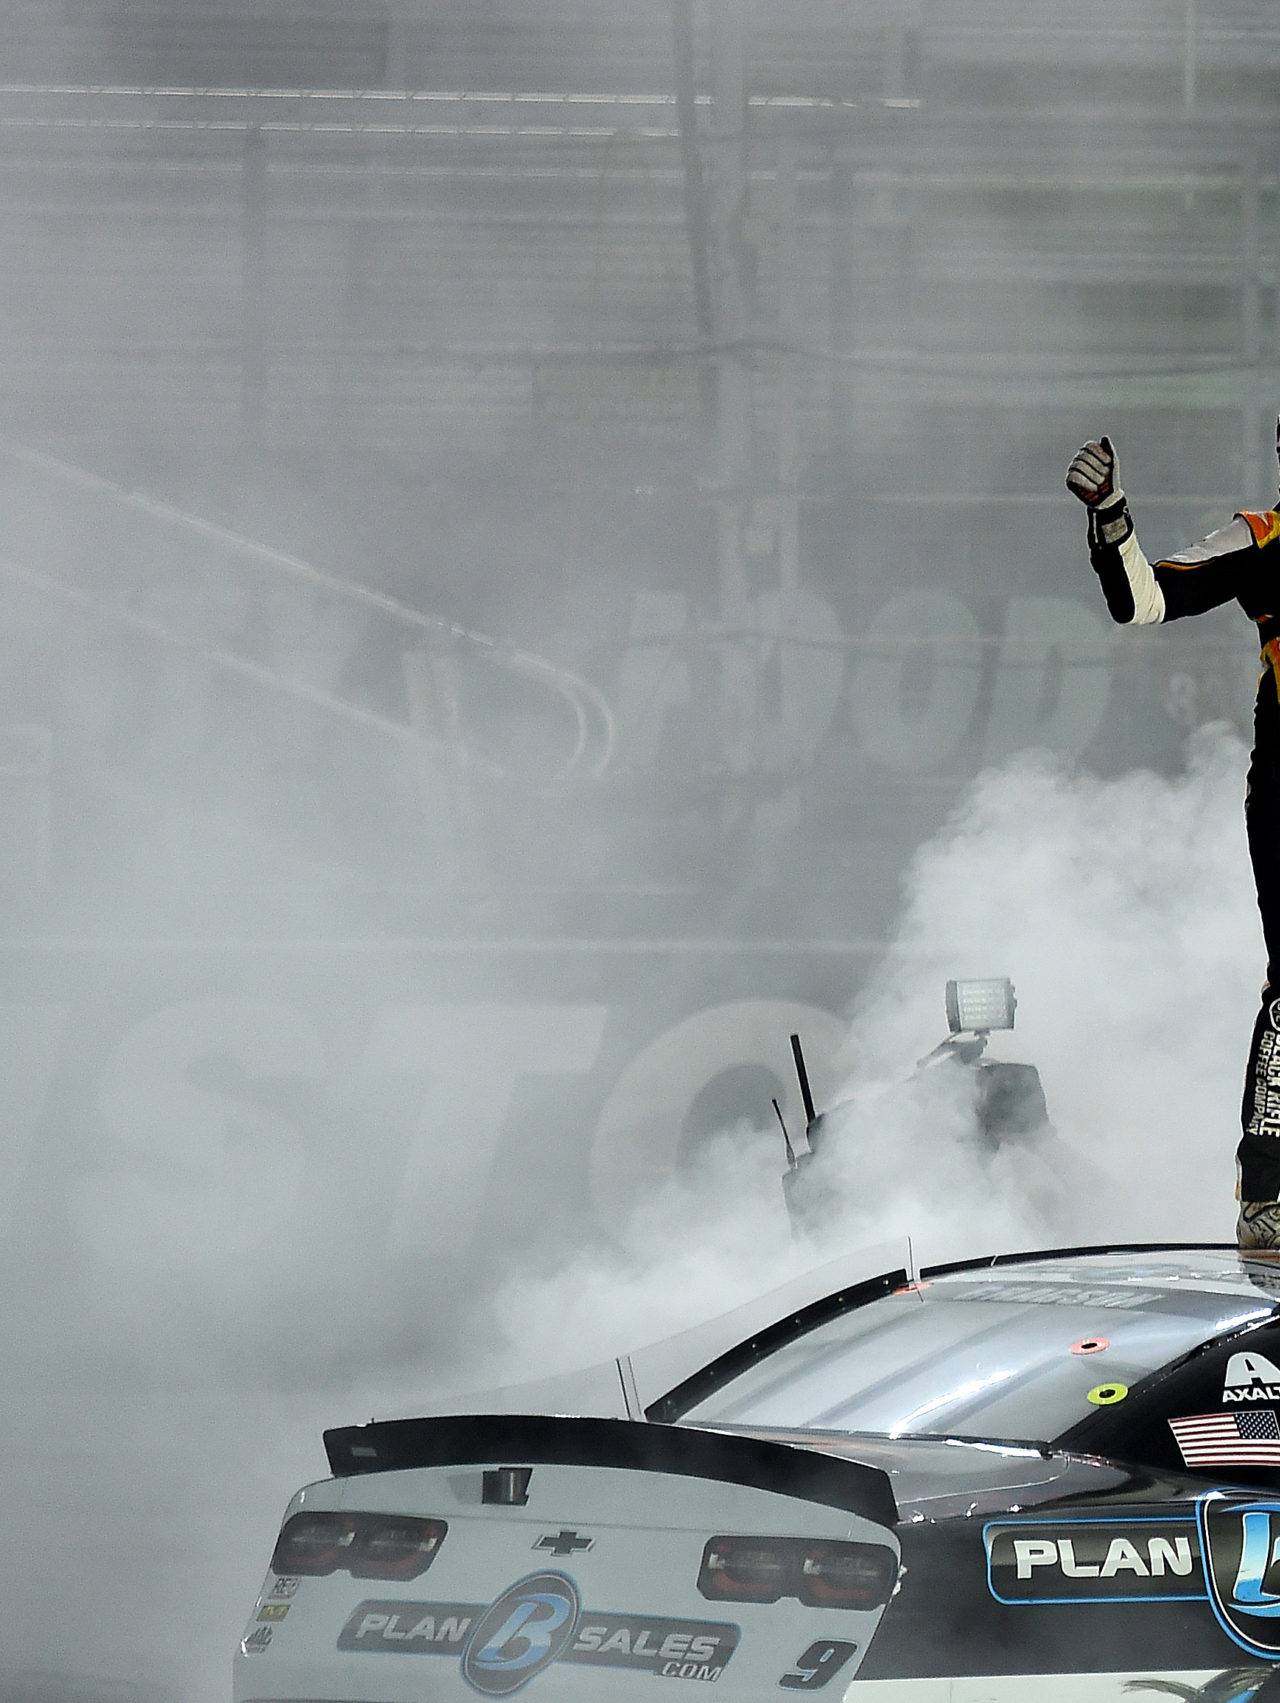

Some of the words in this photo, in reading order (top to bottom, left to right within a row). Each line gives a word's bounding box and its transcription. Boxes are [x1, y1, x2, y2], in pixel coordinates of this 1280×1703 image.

[1255, 1030, 1276, 1077] COFFEE
[1246, 1078, 1268, 1136] COMPANY
[1016, 1537, 1193, 1580] PLAN
[356, 1615, 473, 1643] PLAN
[573, 1625, 722, 1663] SALES
[777, 1637, 859, 1692] 9
